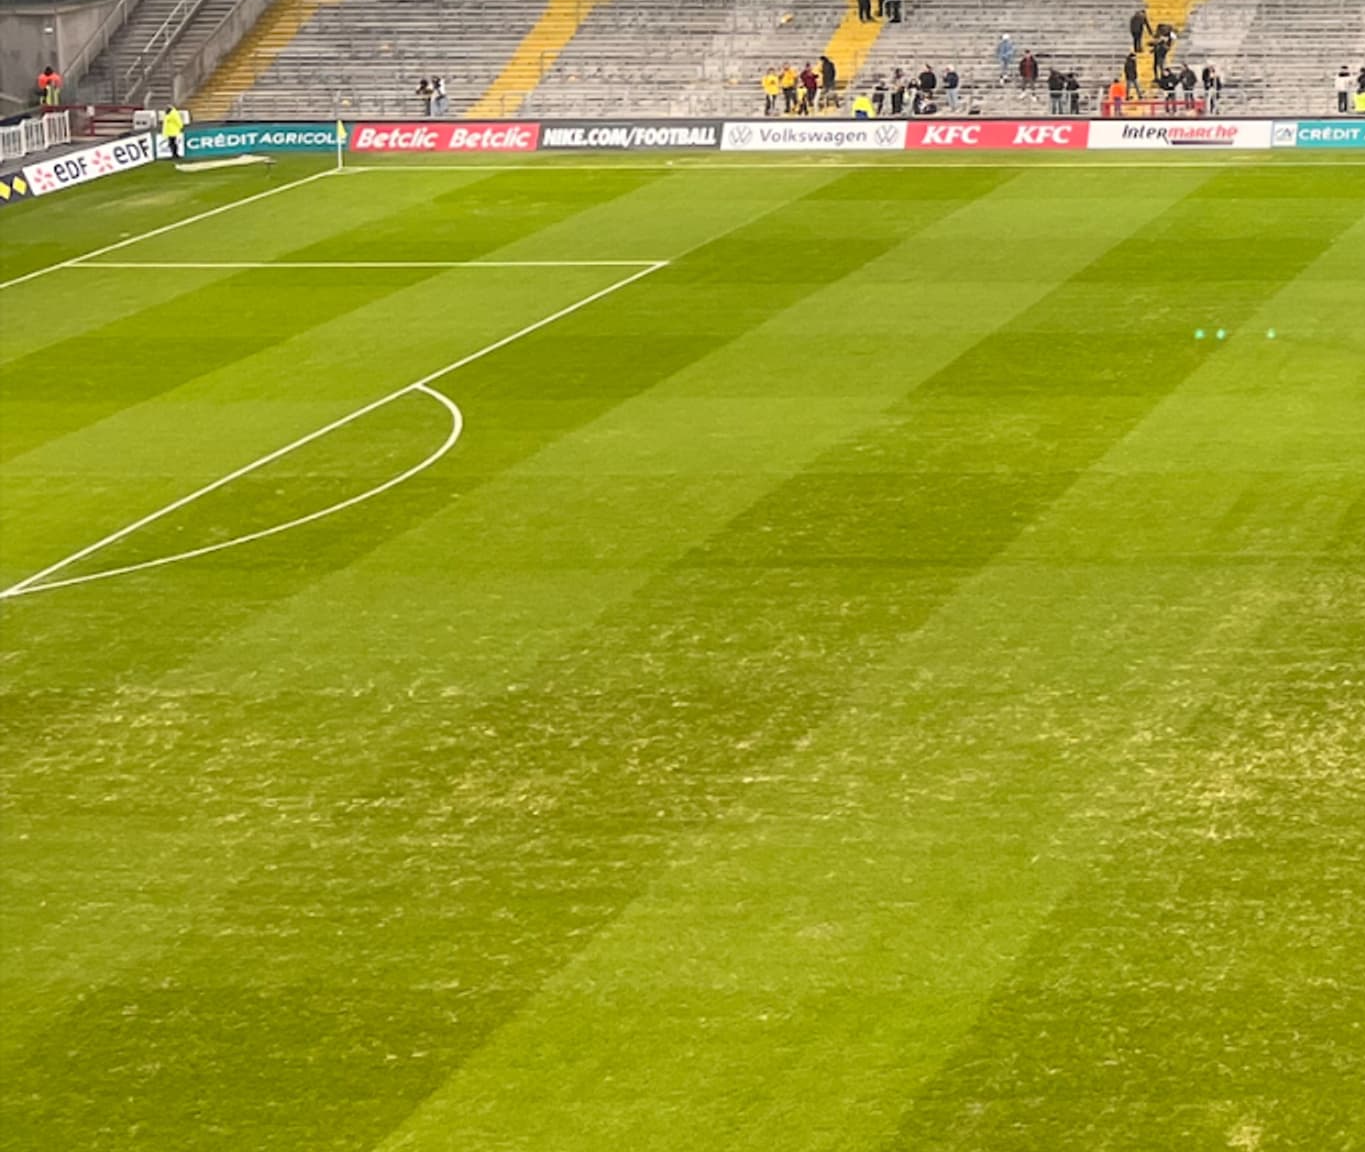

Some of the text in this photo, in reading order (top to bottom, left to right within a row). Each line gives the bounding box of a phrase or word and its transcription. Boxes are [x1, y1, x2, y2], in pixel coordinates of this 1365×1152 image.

[186, 132, 257, 150] CRÉDIT
[356, 127, 532, 149] Betclic Betclic
[542, 127, 716, 147] NIKE.COM/FOOTBALL
[760, 127, 867, 146] Volkswagen
[921, 125, 1072, 145] KFC KFC
[1298, 125, 1363, 141] CRÉDIT
